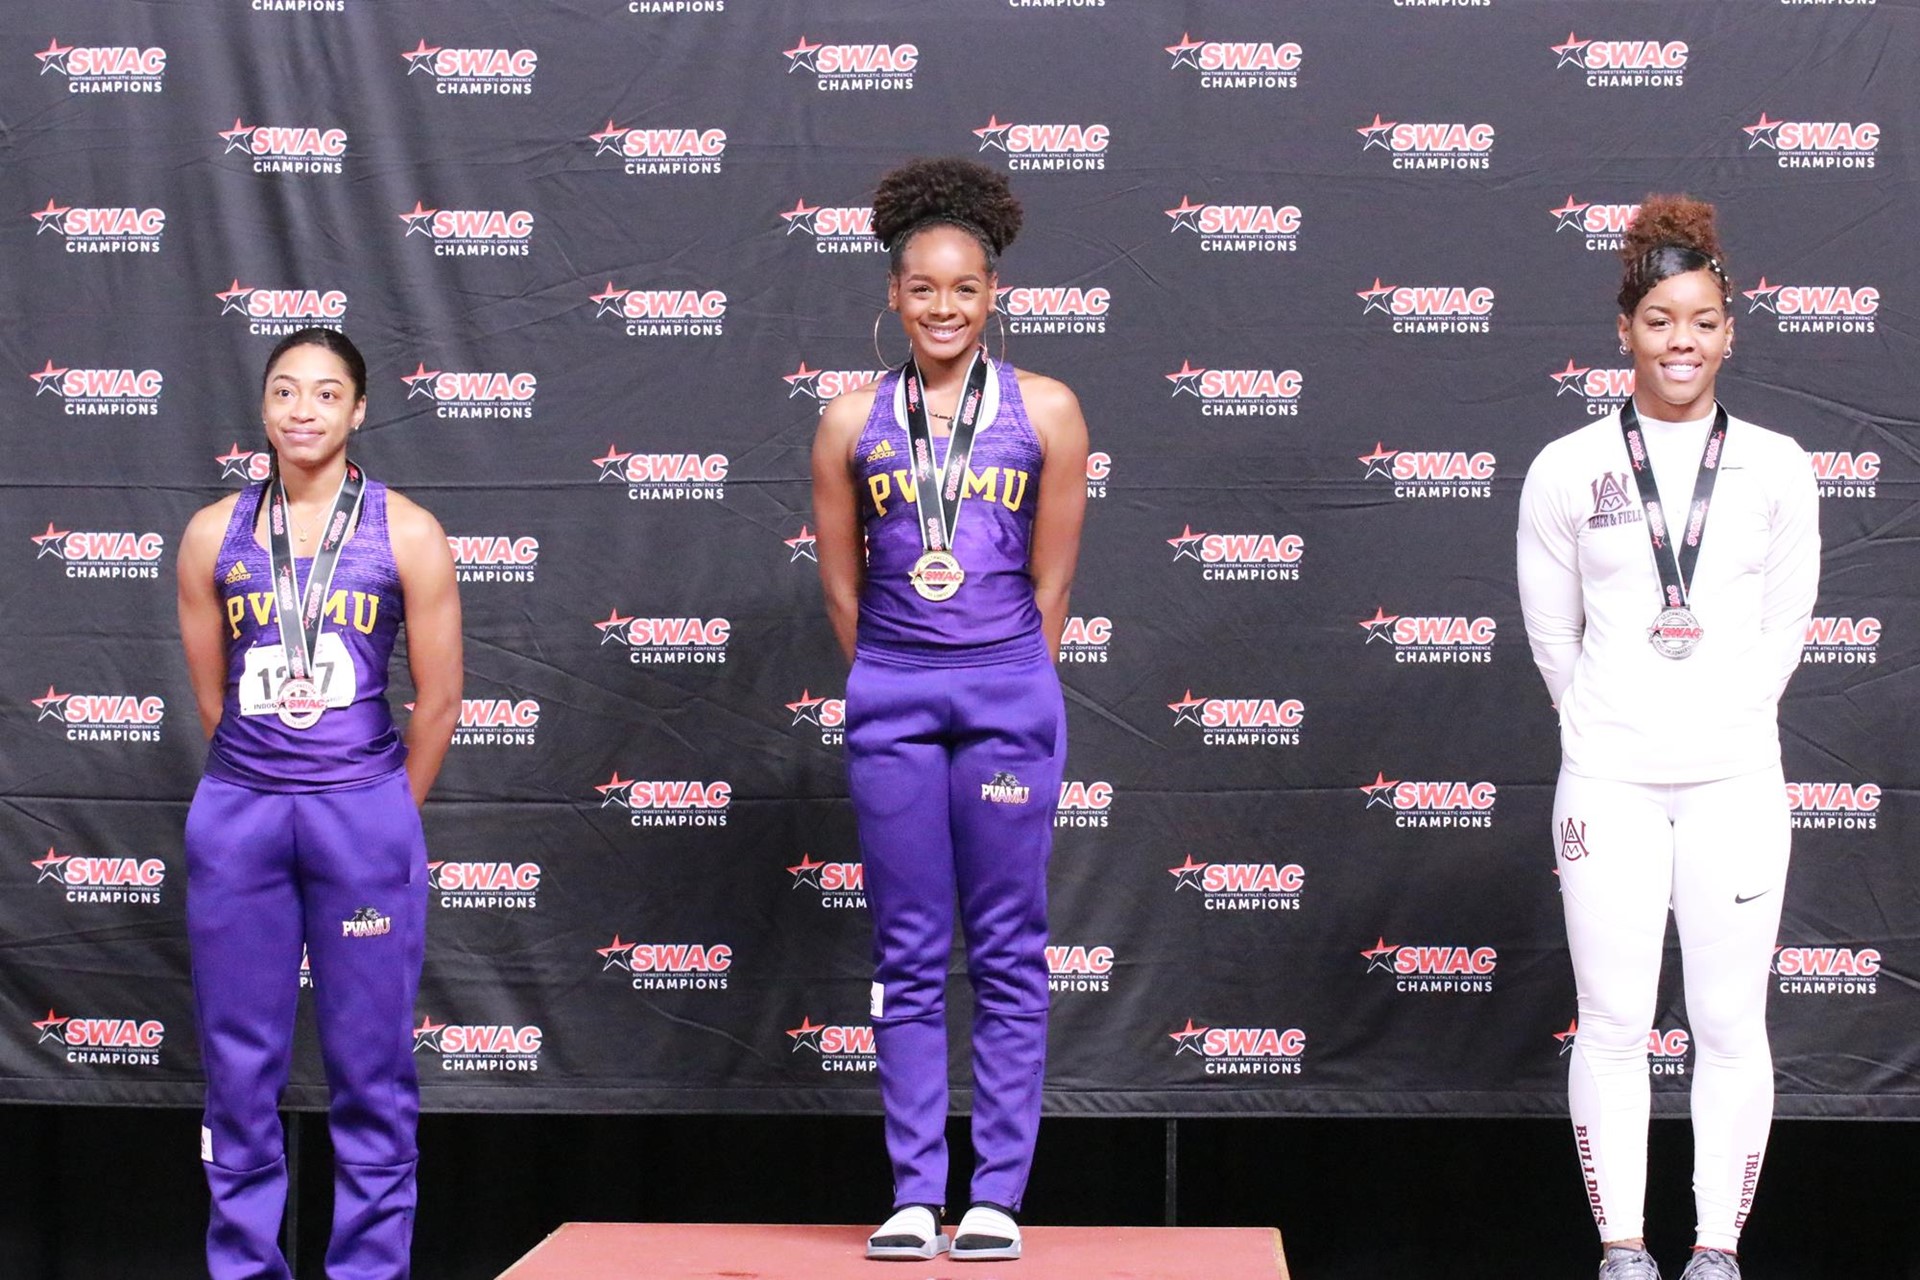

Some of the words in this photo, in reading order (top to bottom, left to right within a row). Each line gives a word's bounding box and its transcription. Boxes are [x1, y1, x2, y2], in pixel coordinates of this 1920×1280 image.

[252, 0, 344, 11] CHAMPIONS
[629, 1, 724, 13] CHAMPIONS
[66, 47, 166, 76] SWAC
[434, 48, 537, 77] SWAC
[815, 45, 918, 74] SWAC
[1198, 42, 1302, 71] SWAC
[1584, 41, 1688, 70] SWAC
[69, 81, 161, 93] CHAMPIONS
[437, 82, 531, 94] CHAMPIONS
[818, 79, 913, 91] CHAMPIONS
[1201, 76, 1297, 88] CHAMPIONS
[1587, 75, 1683, 87] CHAMPIONS
[251, 127, 347, 156] SWAC
[622, 129, 726, 158] SWAC
[1006, 124, 1109, 153] SWAC
[1390, 123, 1494, 152] SWAC
[1775, 122, 1880, 151] SWAC
[254, 161, 342, 173] CHAMPIONS
[625, 163, 721, 175] CHAMPIONS
[1009, 158, 1104, 170] CHAMPIONS
[1393, 157, 1489, 169] CHAMPIONS
[1778, 156, 1874, 168] CHAMPIONS
[63, 208, 165, 237] SWAC
[432, 211, 534, 240] SWAC
[814, 207, 876, 235] SW
[1198, 205, 1301, 234] SWAC
[1583, 205, 1642, 232] SW
[66, 242, 159, 254] CHAMPIONS
[435, 245, 529, 257] CHAMPIONS
[816, 242, 890, 253] CHAMPIO
[1201, 239, 1296, 251] CHAMPIONS
[246, 288, 347, 317] SWAC
[623, 291, 727, 320] SWAC
[1007, 288, 1110, 317] SWAC
[1390, 287, 1494, 316] SWAC
[1776, 286, 1879, 315] SWAC
[626, 325, 722, 337] CHAMPIONS
[1010, 322, 1105, 334] CHAMPIONS
[1393, 321, 1489, 333] CHAMPIONS
[1779, 320, 1874, 332] CHAMPIONS
[62, 369, 163, 398] SWAC
[434, 372, 536, 401] SWAC
[816, 370, 888, 399] SW
[1199, 369, 1302, 398] SWAC
[1584, 369, 1635, 397] SW
[65, 403, 157, 415] CHAMPIONS
[437, 406, 532, 418] CHAMPIONS
[1202, 403, 1298, 415] CHAMPIONS
[866, 450, 896, 463] adidas
[1392, 452, 1496, 481] SWAC
[1810, 452, 1881, 480] WAC
[626, 454, 728, 483] SWAC
[629, 488, 723, 500] CHAMPIONS
[868, 466, 1029, 517] PVMU
[1395, 486, 1490, 498] CHAMPIONS
[1818, 487, 1877, 498] MPIONS
[63, 532, 163, 561] SWAC
[1200, 534, 1304, 563] SWAC
[66, 566, 158, 578] CHAMPIONS
[224, 573, 252, 584] adidas
[456, 571, 535, 582] AMPIONS
[924, 571, 962, 582] SWAC
[1203, 568, 1299, 580] CHAMPIONS
[227, 589, 380, 640] PVMU
[628, 618, 730, 647] SWAC
[1060, 616, 1112, 645] AC
[1393, 617, 1496, 646] SWAC
[1662, 628, 1701, 639] SWAC
[1804, 617, 1882, 645] WAC
[631, 652, 725, 664] CHAMPIONS
[1059, 651, 1108, 662] PIONS
[1396, 651, 1491, 663] CHAMPIONS
[1803, 652, 1876, 664] AMPIONS
[64, 695, 164, 724] SWAC
[288, 699, 326, 709] SWAC
[457, 699, 540, 727] WAC
[1201, 699, 1304, 728] SWAC
[67, 729, 160, 741] CHAMPIONS
[451, 734, 535, 745] HAMPIONS
[1204, 733, 1299, 745] CHAMPIONS
[628, 782, 731, 811] SWAC
[981, 783, 1030, 804] PVAMU
[1057, 781, 1113, 810] AC
[1393, 782, 1496, 811] SWAC
[631, 816, 726, 828] CHAMPIONS
[1054, 816, 1108, 827] PIONS
[1396, 816, 1491, 828] CHAMPIONS
[1792, 818, 1877, 829] HAMPIONS
[63, 857, 165, 886] SWAC
[438, 862, 540, 891] SWAC
[820, 862, 863, 890] SW
[1202, 864, 1305, 893] SWAC
[66, 891, 160, 903] CHAMPIONS
[441, 896, 536, 908] CHAMPIONS
[1205, 898, 1299, 910] CHAMPIONS
[342, 917, 391, 937] PVAMU
[630, 946, 732, 975] SWAC
[1394, 947, 1497, 976] SWAC
[1777, 947, 1881, 976] SWAC
[633, 980, 727, 992] CHAMPIONS
[1048, 980, 1109, 991] MPIONS
[1397, 981, 1492, 993] CHAMPIONS
[1780, 981, 1876, 993] CHAMPIONS
[64, 1020, 164, 1049] SWAC
[439, 1026, 542, 1055] SWAC
[820, 1026, 876, 1054] SW
[1202, 1029, 1305, 1058] SWAC
[1647, 1029, 1690, 1057] AC
[67, 1054, 159, 1066] CHAMPIONS
[442, 1060, 537, 1072] CHAMPIONS
[822, 1060, 877, 1072] CHAMP
[1205, 1063, 1301, 1075] CHAMPIONS
[1576, 1124, 1607, 1226] BULLDOGS
[1741, 1152, 1760, 1196] TRACK
[1740, 1198, 1751, 1208] &
